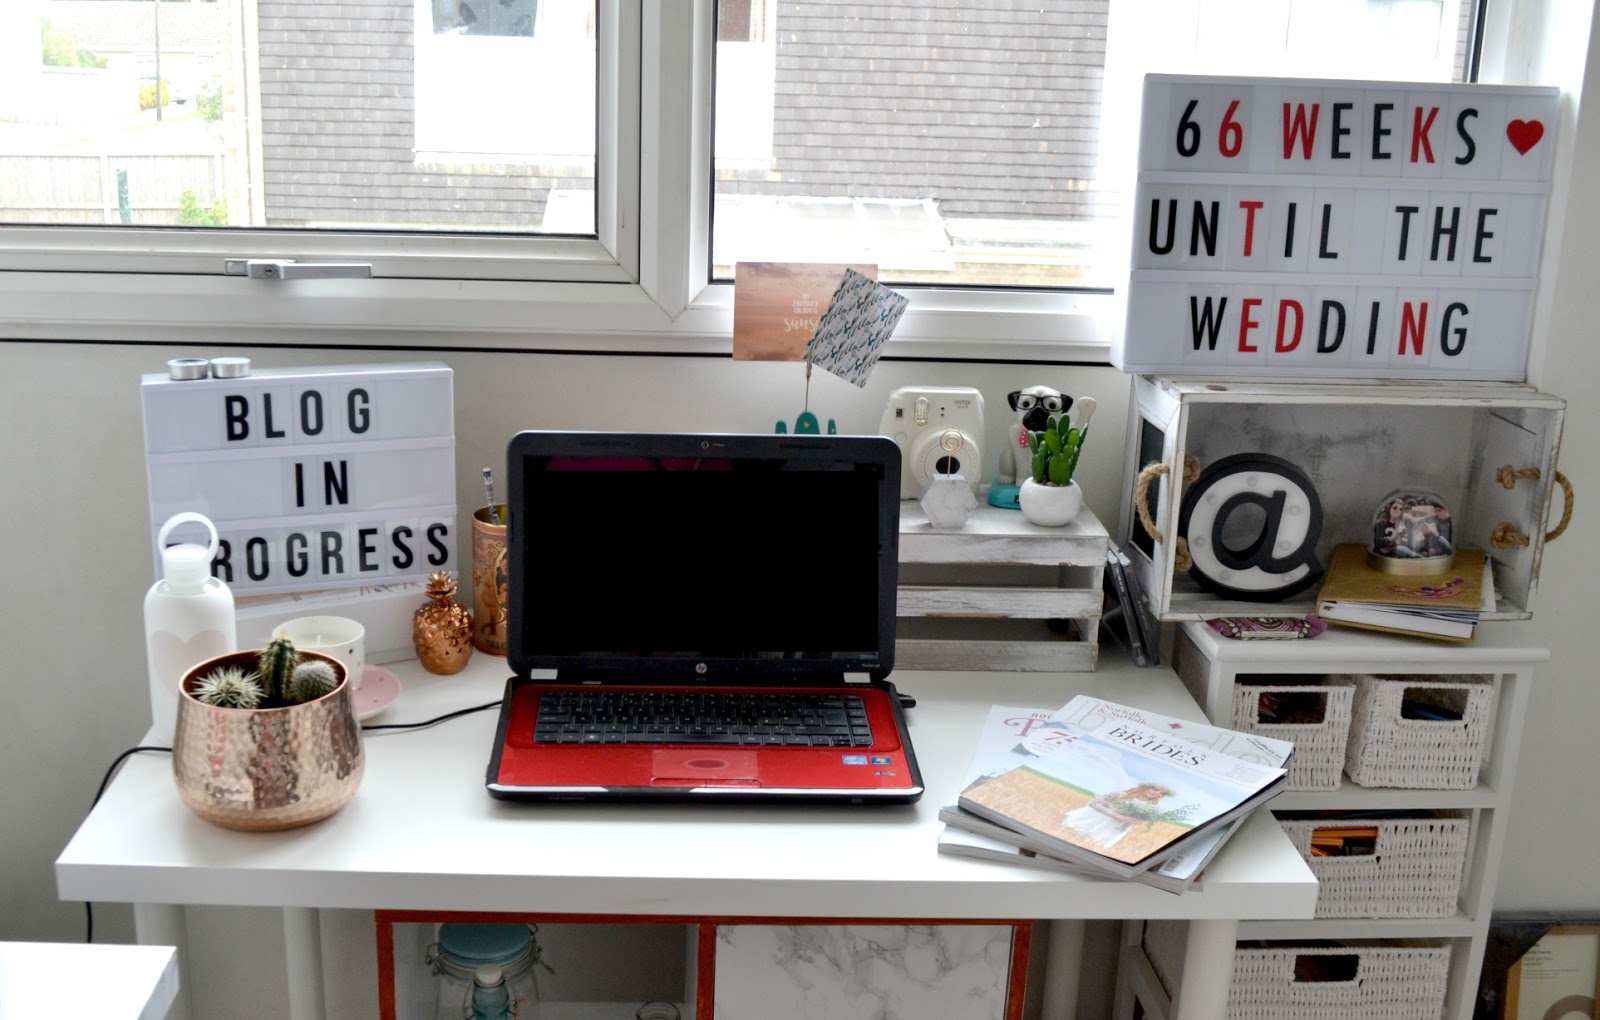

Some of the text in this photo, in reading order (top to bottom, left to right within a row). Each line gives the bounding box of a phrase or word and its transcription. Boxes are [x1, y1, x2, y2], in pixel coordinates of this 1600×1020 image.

[1175, 99, 1479, 165] 66 WEEKS
[1148, 199, 1498, 263] UNTIL THE
[1190, 296, 1469, 357] WEDDING
[224, 388, 370, 442] BLOG
[294, 460, 349, 508] IN
[166, 522, 449, 583] ROGRESS
[1107, 726, 1200, 767] BRIDES
